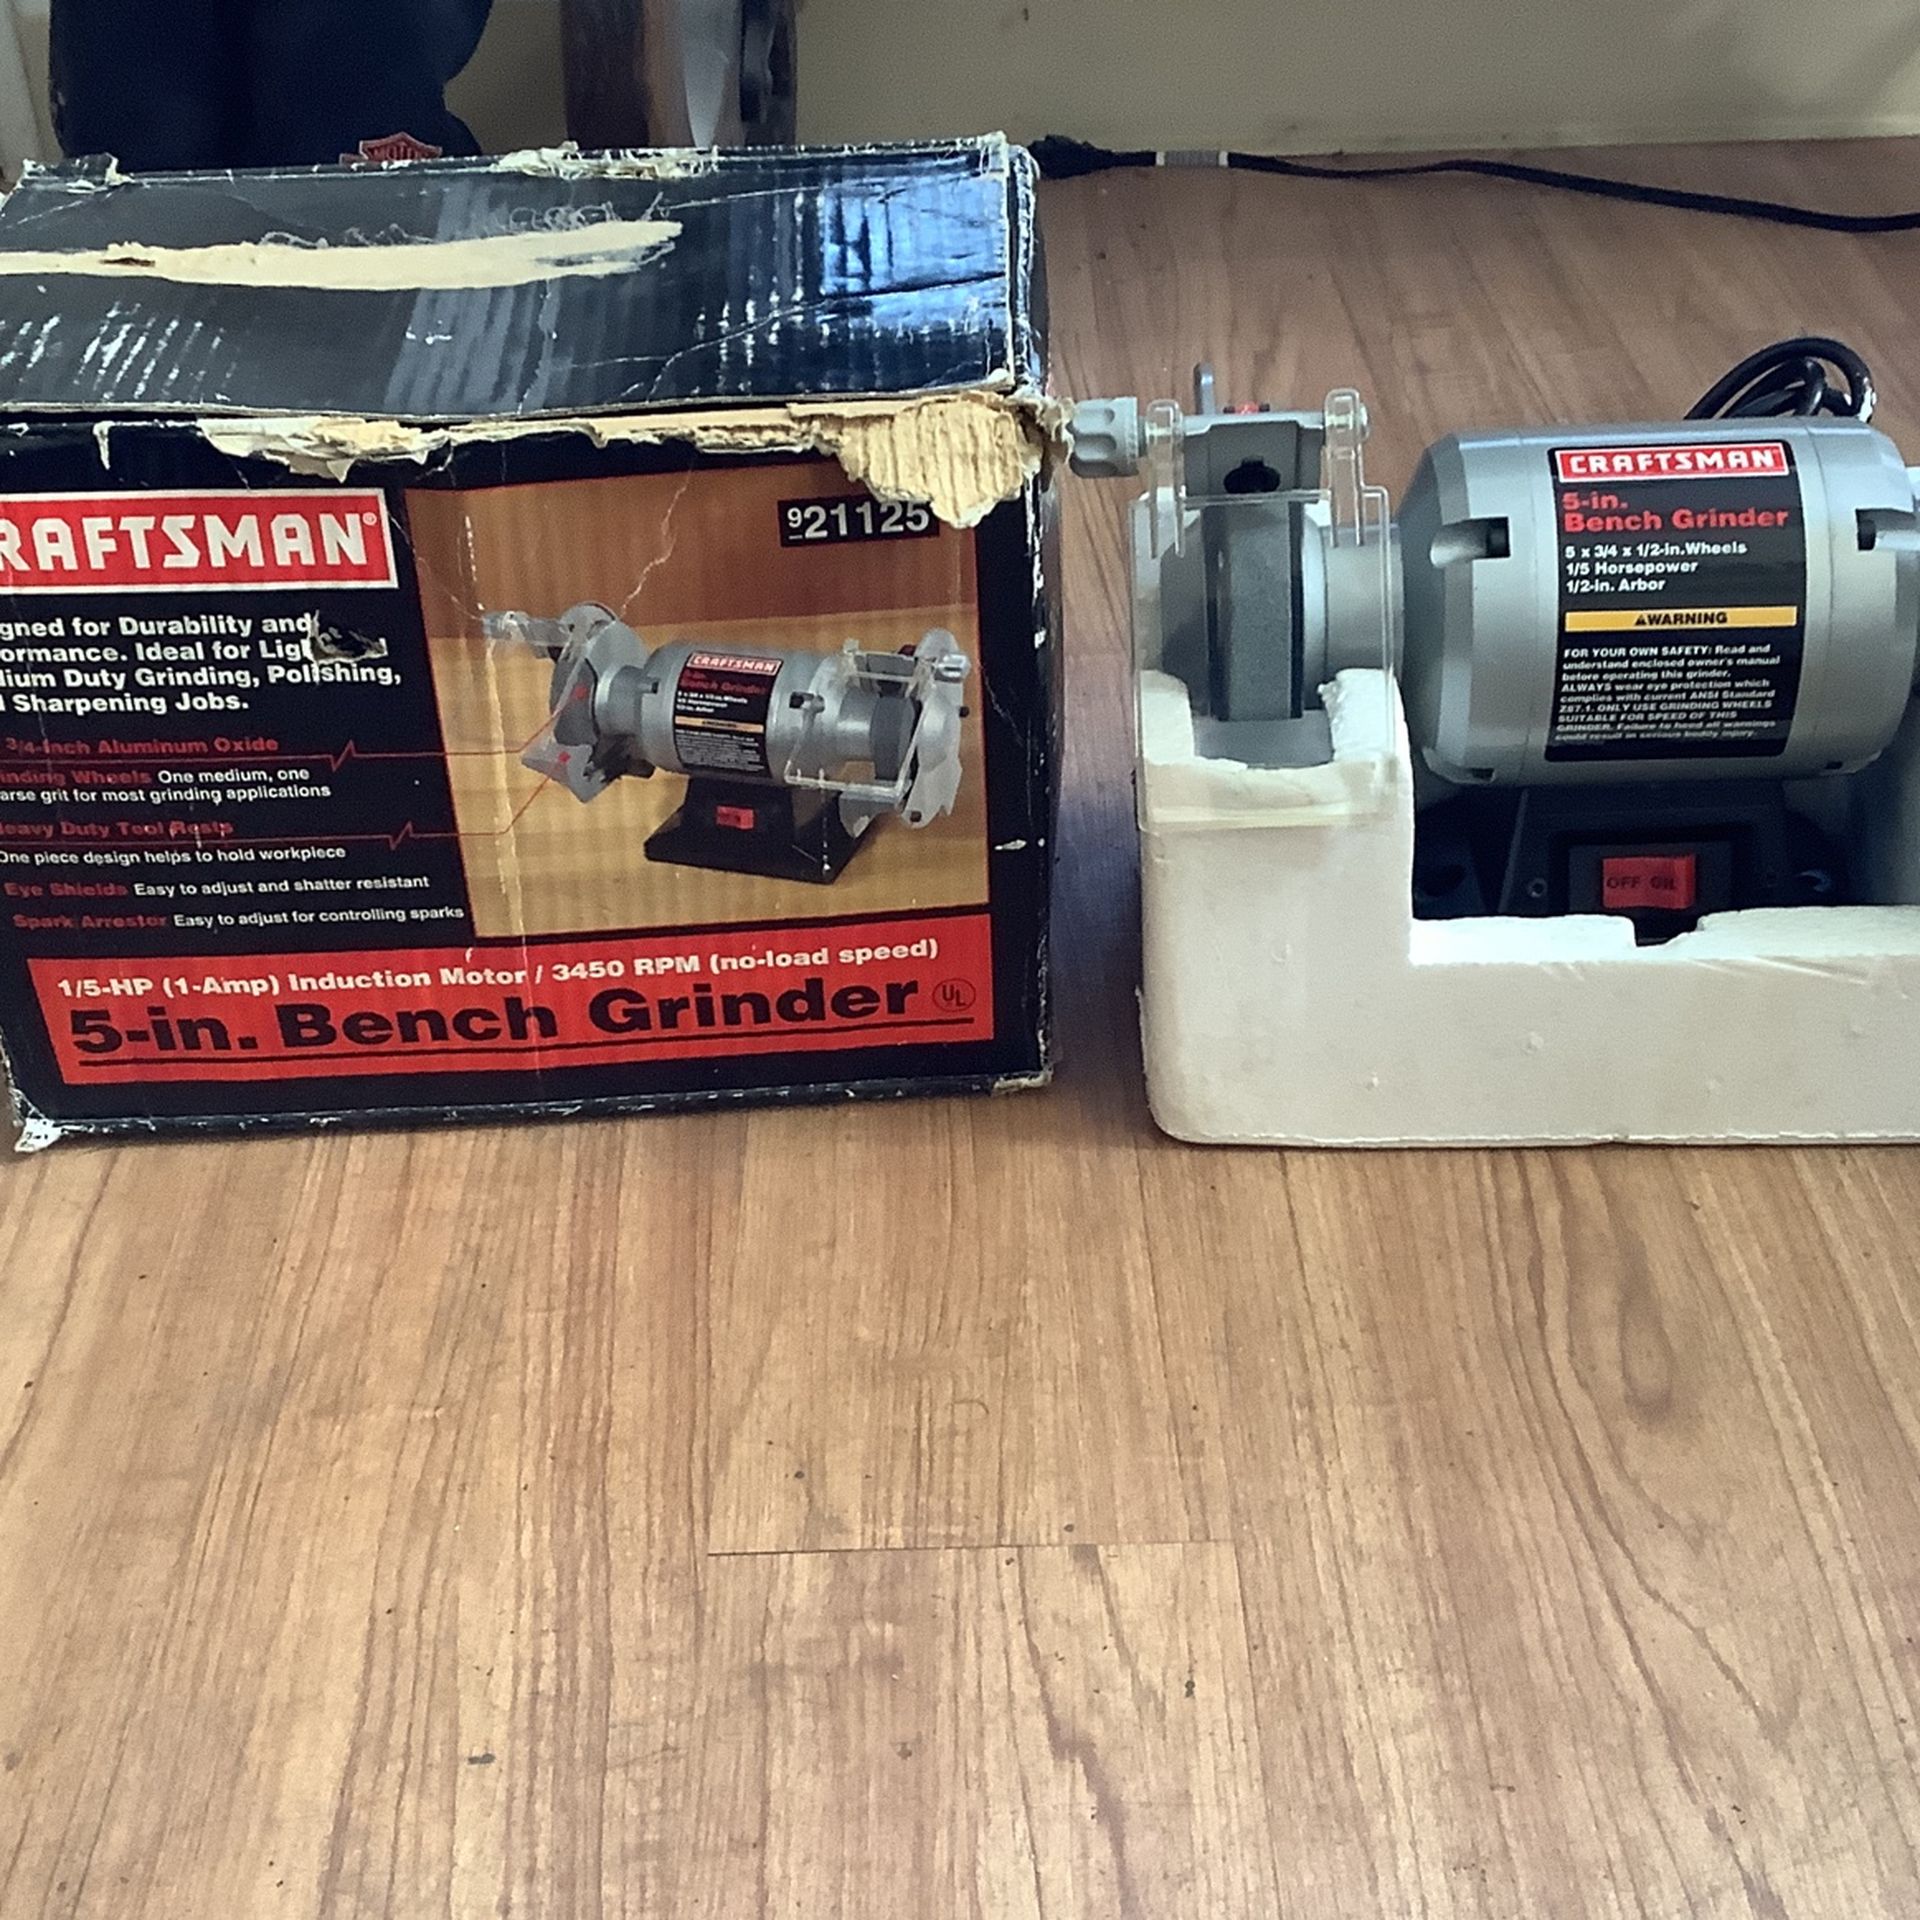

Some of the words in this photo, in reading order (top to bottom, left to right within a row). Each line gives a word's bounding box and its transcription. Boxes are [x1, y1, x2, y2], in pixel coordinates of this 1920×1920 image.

[1569, 449, 1775, 474] CRAFTSMAN
[1562, 490, 1629, 510] 5-in.
[1564, 509, 1663, 532] Bench
[1671, 507, 1789, 530] Grinder
[1564, 545, 1576, 559] 5
[1581, 547, 1591, 558] x
[1594, 544, 1618, 559] 3/4
[1622, 546, 1632, 557] x
[1566, 562, 1591, 577] 1/5
[1594, 561, 1699, 576] Horsepower
[1566, 578, 1615, 594] 1/2-in.
[1618, 577, 1667, 592] Arbor
[0, 617, 66, 641] gned
[72, 616, 111, 636] for
[118, 614, 253, 638] Durability
[261, 612, 312, 634] and
[1646, 611, 1728, 626] WARNING
[0, 646, 128, 662] ormance.
[135, 642, 205, 662] Ideal
[212, 641, 250, 660] for
[1563, 647, 1589, 658] FOR
[1592, 647, 1627, 658] YOUR
[1629, 646, 1659, 657] OWN
[1714, 644, 1746, 655] Read
[1748, 643, 1771, 654] and
[692, 655, 776, 673] CRAFTSMAN
[1562, 659, 1629, 670] understand
[1631, 658, 1685, 669] enclosed
[1736, 655, 1781, 666] manual
[63, 668, 127, 691] Duty
[135, 666, 260, 688] Grinding,
[266, 662, 402, 686] Polishing,
[1562, 671, 1600, 682] before
[1661, 669, 1684, 679] this
[1561, 682, 1612, 693] ALWAYS
[1614, 683, 1645, 692] wear
[1646, 682, 1669, 692] eye
[1670, 680, 1732, 692] protection
[1734, 678, 1771, 688] which
[1689, 689, 1720, 700] ANSI
[1721, 689, 1776, 699] Standard
[12, 692, 168, 717] Sharpening
[174, 691, 249, 711] Jobs.
[1597, 703, 1631, 713] ONLY
[1632, 702, 1658, 712] USE
[1659, 701, 1720, 711] GRINDING
[1721, 699, 1773, 709] WHEELS
[1558, 713, 1617, 723] SUITABLE
[98, 737, 209, 755] Aluminum
[213, 736, 279, 753] Oxide
[71, 770, 151, 785] Wheels
[157, 769, 194, 784] One
[198, 768, 274, 784] medium,
[277, 768, 310, 781] one
[40, 788, 70, 805] grit
[72, 788, 97, 801] for
[102, 788, 146, 802] most
[150, 786, 222, 805] grinding
[226, 784, 332, 803] applications
[60, 821, 110, 839] Duty
[116, 820, 165, 837] Tool
[0, 850, 30, 864] One
[34, 850, 80, 867] piece
[83, 850, 141, 867] design
[144, 849, 192, 866] helps
[196, 850, 214, 863] to
[217, 848, 256, 862] hold
[259, 845, 347, 862] workpiece
[3, 881, 44, 898] Eye
[50, 881, 129, 897] Shields
[133, 882, 176, 899] Easy
[180, 882, 198, 896] to
[201, 880, 254, 897] adjust
[258, 879, 290, 893] and
[294, 878, 352, 892] shatter
[356, 875, 431, 890] resistant
[1606, 876, 1642, 889] OFF
[12, 913, 74, 930] Spark
[173, 913, 214, 929] Easy
[217, 912, 235, 926] to
[238, 911, 290, 928] adjust
[292, 910, 315, 923] for
[318, 907, 407, 923] controlling
[410, 905, 466, 922] sparks
[57, 978, 154, 999] 1/5-HP
[162, 974, 280, 999] (1-Amp)
[287, 969, 432, 992] Induction
[438, 967, 527, 986] Motor
[551, 958, 625, 982] 3450
[632, 954, 702, 978] RPM
[709, 946, 830, 975] (no-load
[838, 937, 940, 965] speed)
[70, 1005, 259, 1054] 5-in.
[274, 995, 559, 1048] Bench
[588, 976, 920, 1034] Grinder
